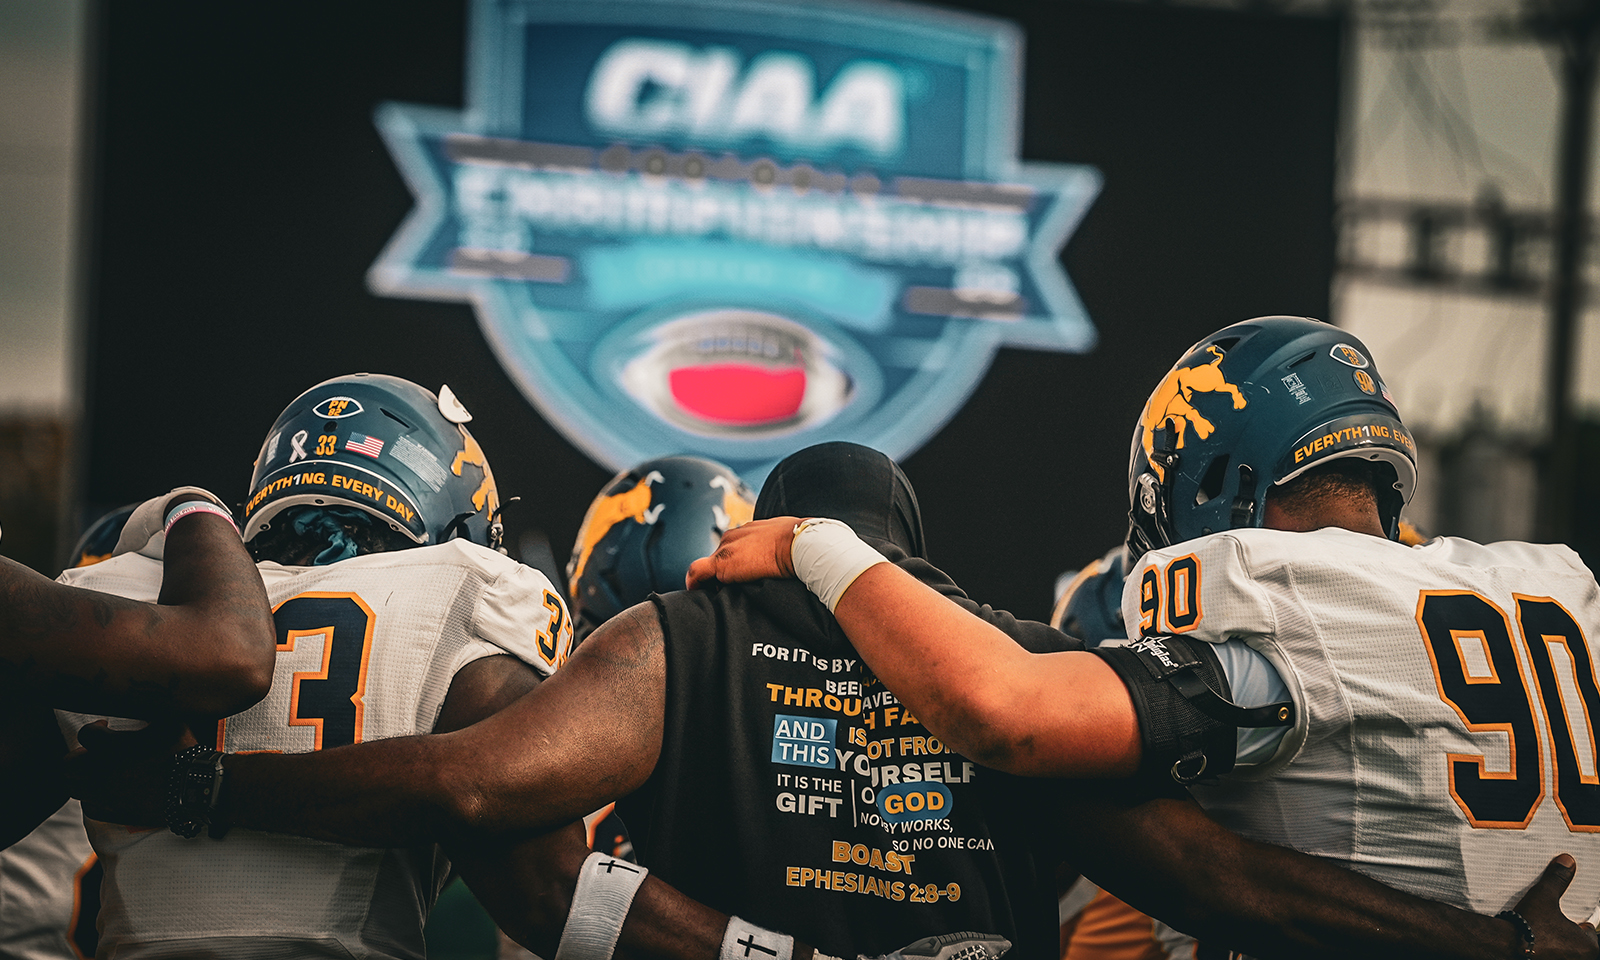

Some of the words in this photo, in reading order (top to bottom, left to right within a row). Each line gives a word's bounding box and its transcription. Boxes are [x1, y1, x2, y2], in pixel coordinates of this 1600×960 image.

[585, 38, 903, 157] CIAA
[327, 408, 343, 417] 82
[328, 400, 349, 409] PN
[316, 434, 338, 456] 33
[331, 474, 384, 502] EVERY
[386, 494, 414, 523] DAY
[1139, 552, 1203, 637] 90
[751, 643, 789, 661] FOR
[792, 648, 810, 662] IT
[812, 655, 829, 671] IS
[832, 659, 856, 673] BY
[1415, 589, 1600, 833] 90
[775, 719, 826, 740] AND
[779, 742, 830, 765] THIS
[848, 726, 867, 747] IS
[866, 738, 895, 760] OT
[777, 773, 791, 787] IT
[794, 775, 809, 790] IS
[811, 777, 843, 793] THE
[775, 791, 843, 818] GIFT
[884, 791, 945, 814] GOD
[900, 818, 954, 834] WORKS,
[891, 839, 909, 852] SO
[913, 837, 934, 850] NO
[937, 836, 965, 849] ONE
[832, 840, 916, 875] BOAST
[786, 866, 905, 901] EPHESIANS
[908, 882, 962, 903] 2:8-9
